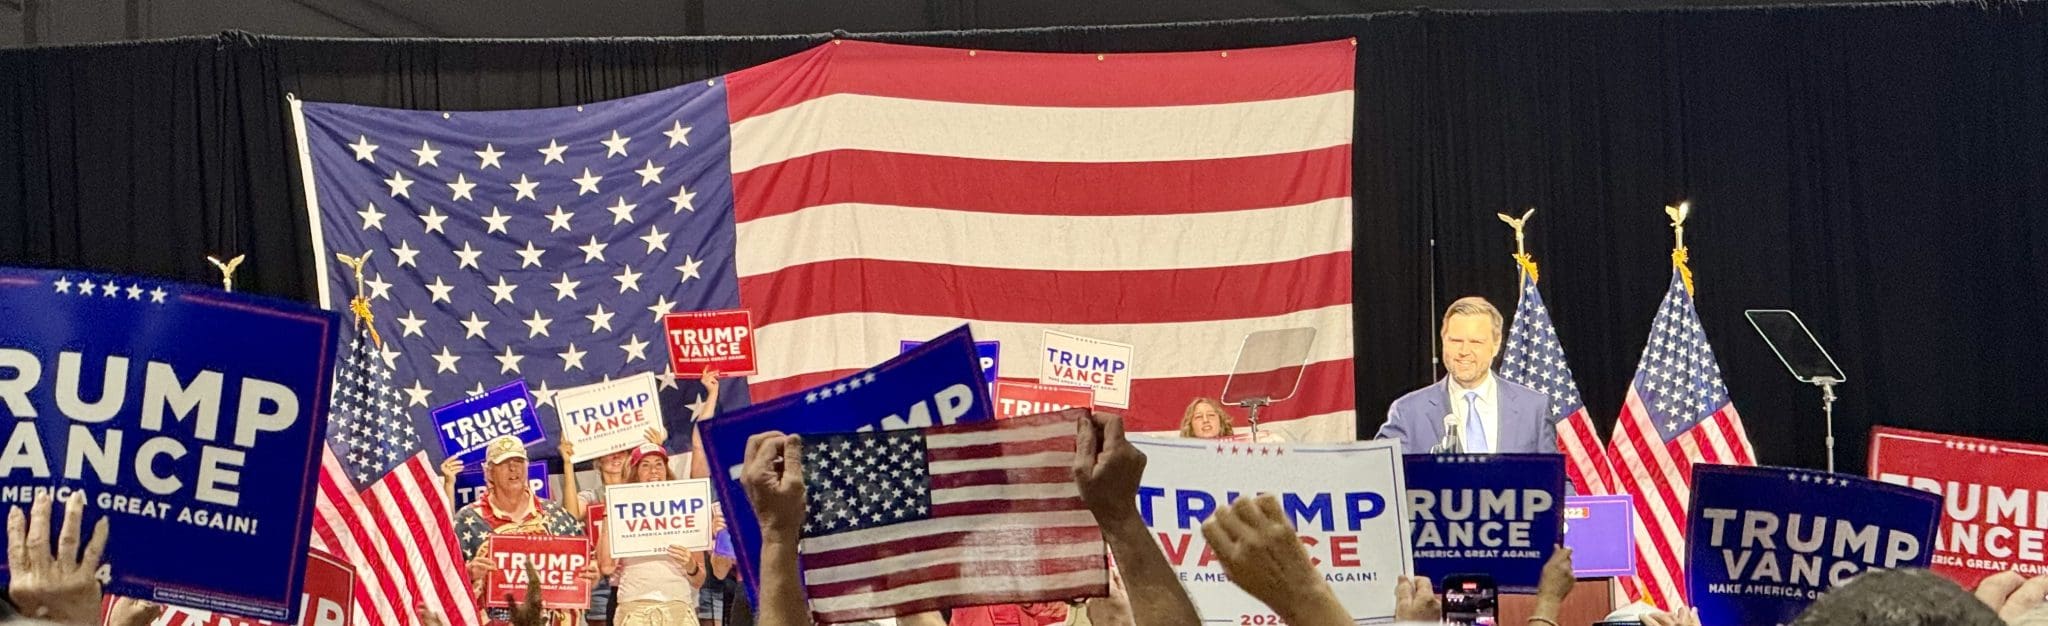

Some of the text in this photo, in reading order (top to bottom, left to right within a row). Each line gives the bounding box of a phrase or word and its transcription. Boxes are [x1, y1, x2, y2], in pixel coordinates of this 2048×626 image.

[670, 326, 748, 345] TRUMP
[680, 342, 741, 357] VANCE
[1047, 347, 1125, 373] TRUMP
[1054, 364, 1114, 385] VANCE
[0, 348, 299, 448] RUMP
[567, 393, 649, 425] TRUMP
[441, 398, 527, 439] TRUMP
[580, 410, 645, 435] VANCE
[456, 416, 524, 449] VANCE
[0, 421, 246, 507] ANCE
[97, 492, 171, 520] GREAT
[177, 507, 258, 535] AGAIN!
[614, 498, 704, 519] TRUMP
[1137, 486, 1385, 531] TRMP
[1406, 489, 1553, 521] RUMP
[625, 515, 695, 532] VANCE
[1410, 521, 1531, 547] ANCE
[1703, 508, 1919, 568] TRUMP
[494, 552, 585, 571] TRUMP
[1722, 549, 1886, 588] VANC
[1966, 558, 2008, 571] GREAT
[1325, 572, 1377, 583] AGAIN!
[1709, 583, 1741, 594] MAKE
[1745, 585, 1802, 598] AMERICA
[1241, 614, 1288, 625] 202
